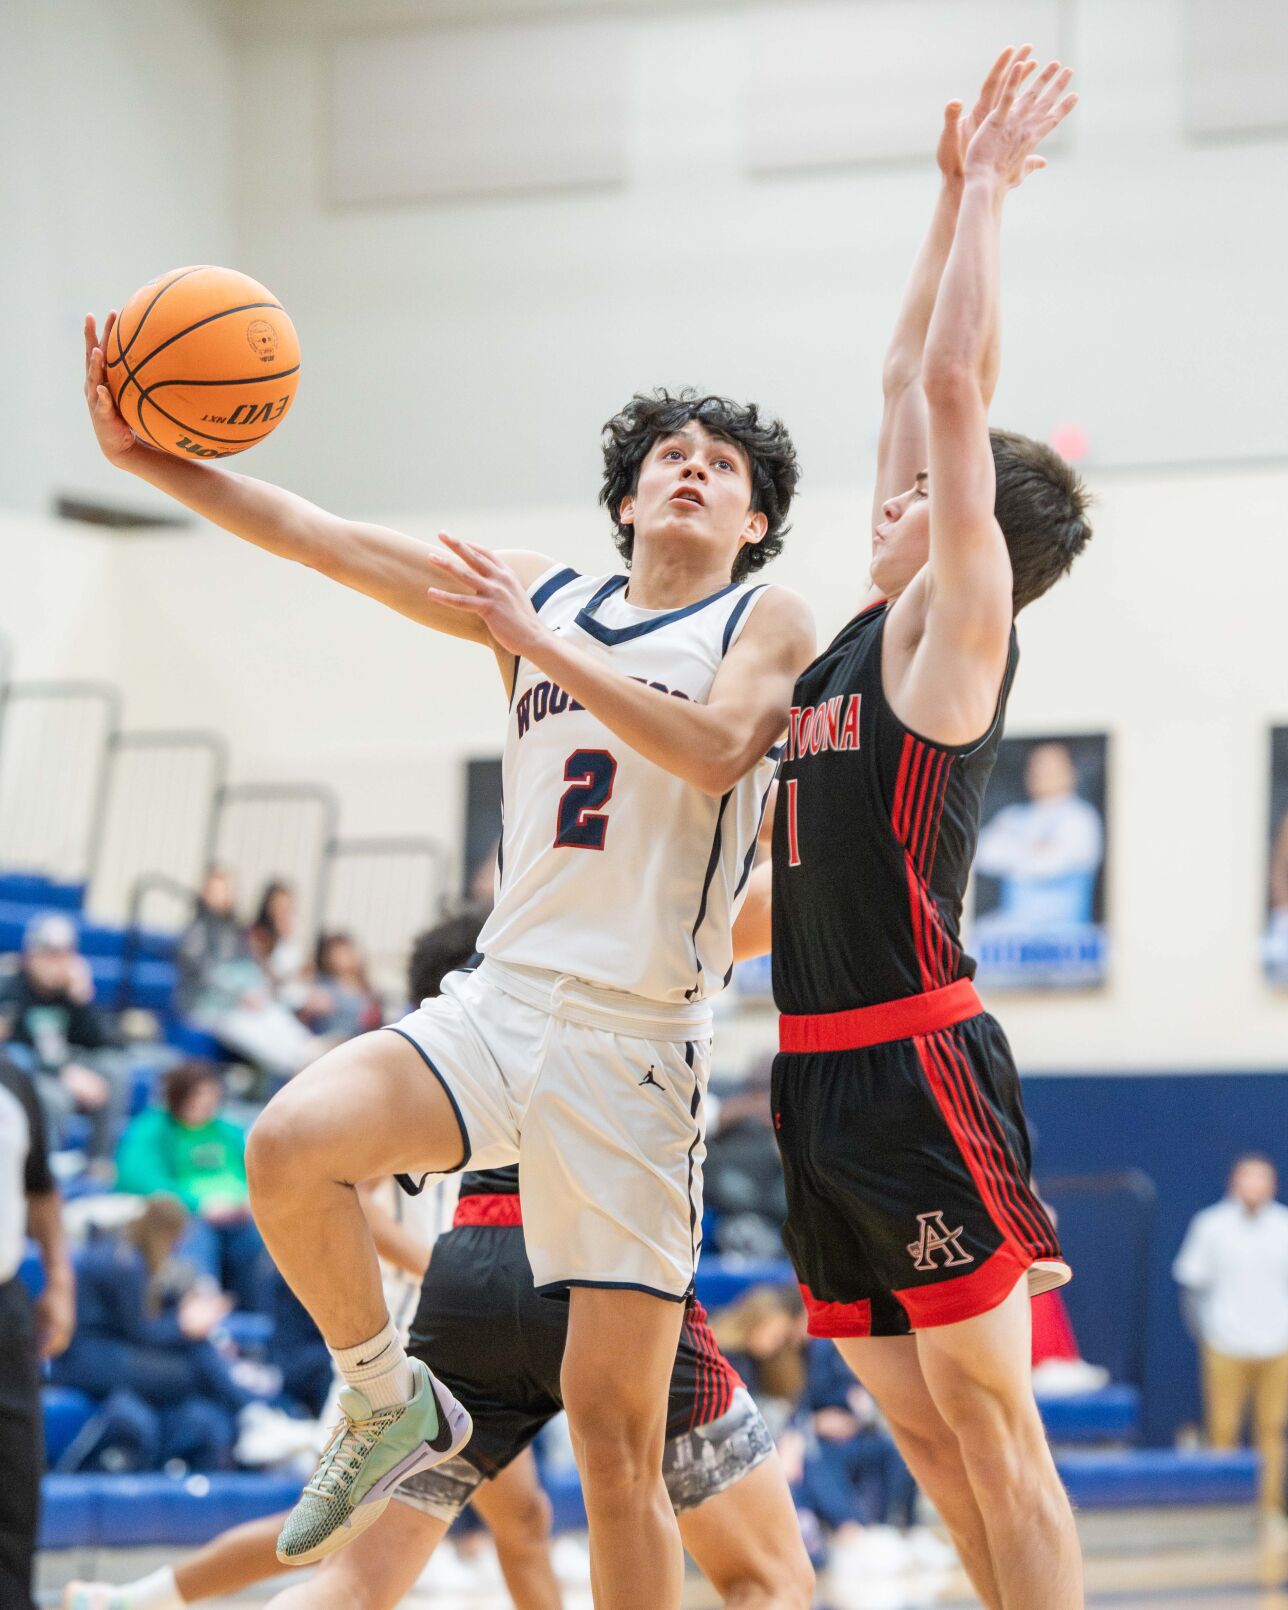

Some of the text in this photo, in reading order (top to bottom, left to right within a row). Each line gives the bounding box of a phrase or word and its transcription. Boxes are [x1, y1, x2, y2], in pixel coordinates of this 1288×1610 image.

[227, 395, 289, 425] EVO
[782, 693, 862, 762] TOONA
[553, 749, 617, 851] 2
[786, 778, 801, 867] 1
